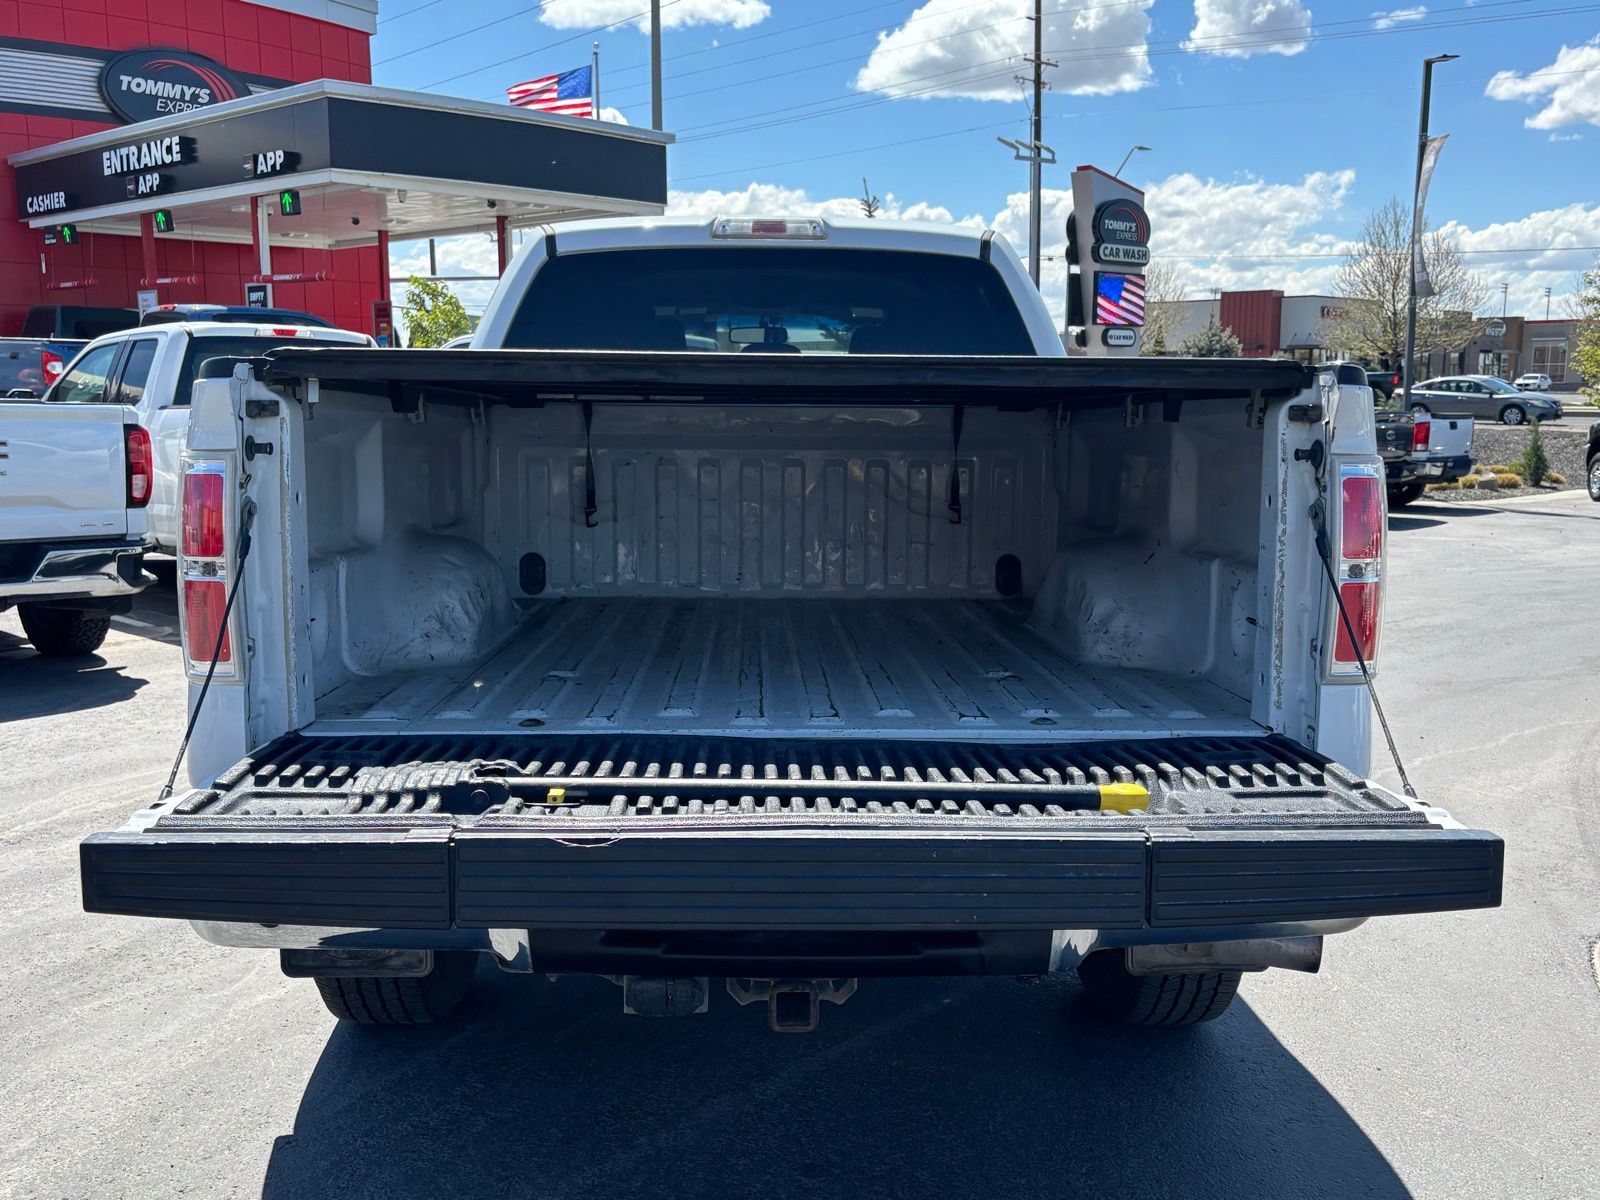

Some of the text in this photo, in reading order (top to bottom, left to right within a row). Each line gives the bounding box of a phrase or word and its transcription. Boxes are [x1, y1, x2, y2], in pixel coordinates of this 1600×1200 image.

[120, 75, 211, 104] TOMMY'S
[156, 98, 205, 114] EXPR
[102, 135, 182, 176] ENTRANCE
[256, 149, 285, 175] APP
[138, 172, 160, 195] APP
[26, 191, 66, 214] CASHIER
[1104, 219, 1137, 232] TOMMY'S
[1115, 231, 1138, 241] EXPRESS
[1102, 246, 1148, 261] CAR WASH
